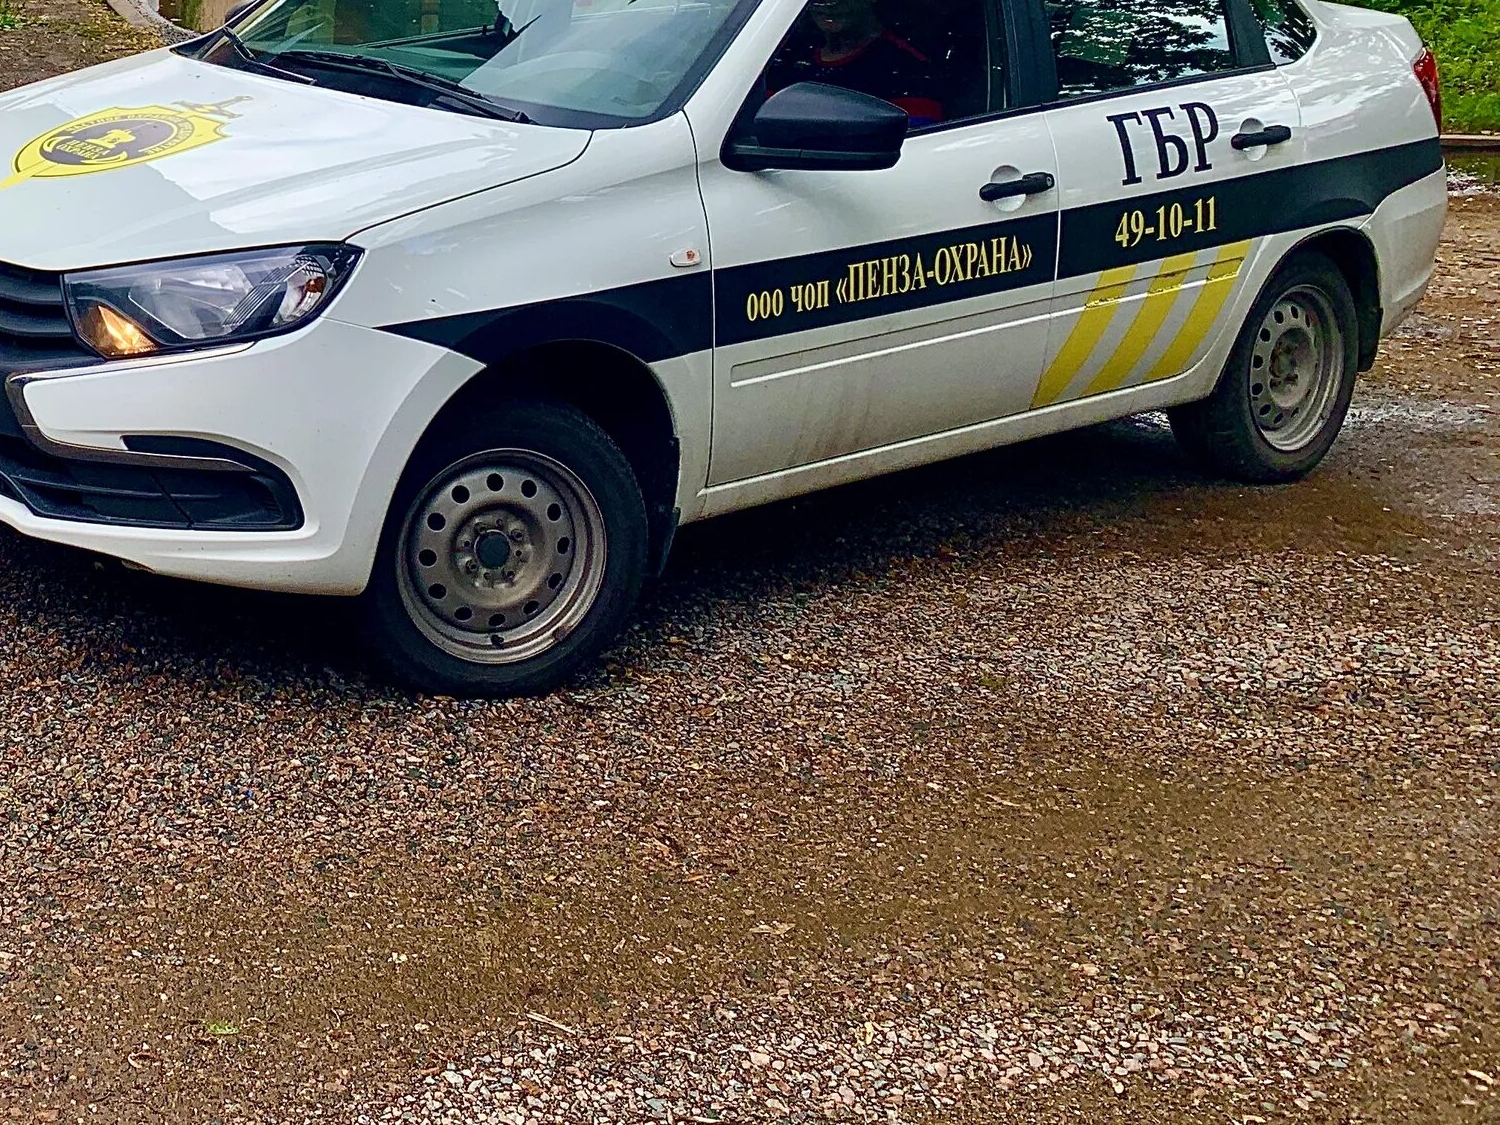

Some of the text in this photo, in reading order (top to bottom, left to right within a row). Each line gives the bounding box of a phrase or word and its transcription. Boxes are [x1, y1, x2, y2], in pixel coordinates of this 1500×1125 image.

[1106, 102, 1219, 186] ГБР
[1115, 196, 1217, 248] 49-10-11
[746, 235, 1033, 321] ООО ЧОП «ПЕНЗА-ОХРАНА»
